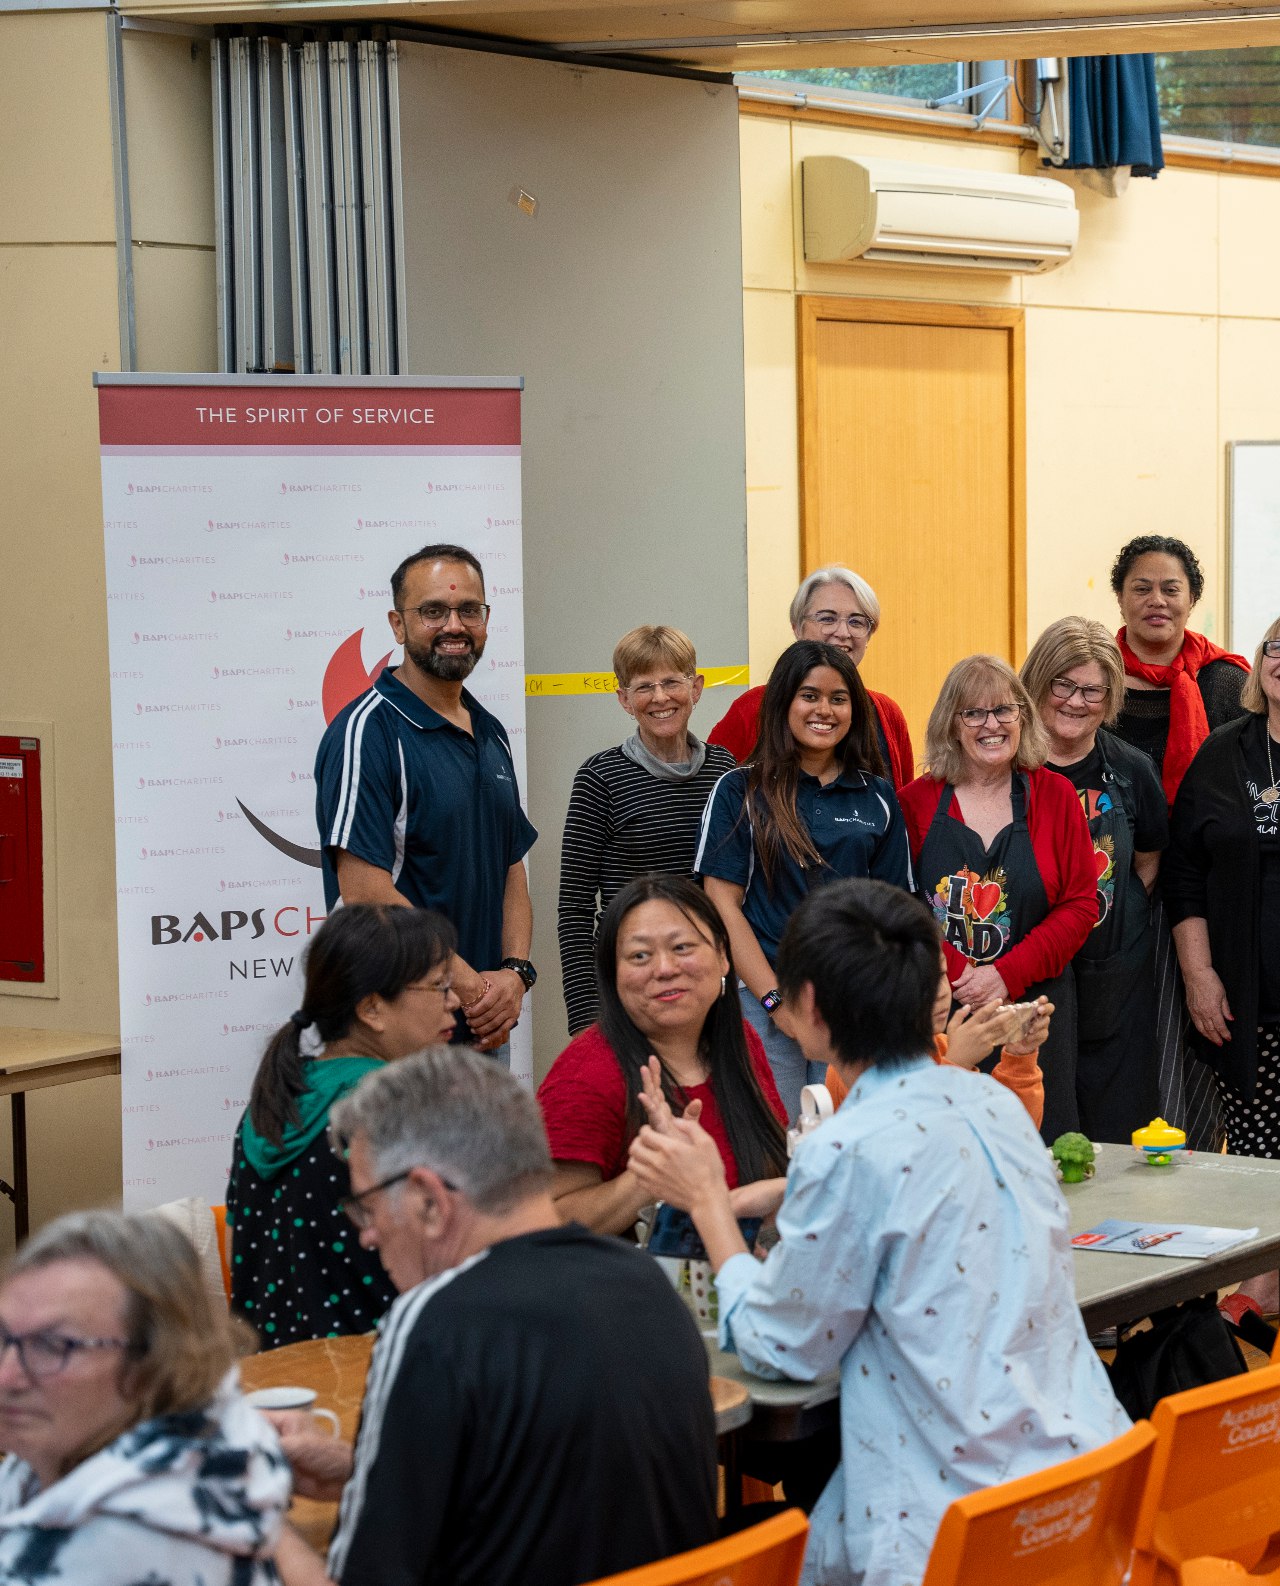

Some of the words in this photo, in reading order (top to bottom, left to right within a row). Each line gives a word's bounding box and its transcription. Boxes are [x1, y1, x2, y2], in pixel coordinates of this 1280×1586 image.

[196, 407, 237, 423] THE
[246, 408, 307, 423] SPIRIT
[316, 408, 344, 424] OF
[352, 408, 435, 424] SERVICE
[230, 957, 294, 980] NEW
